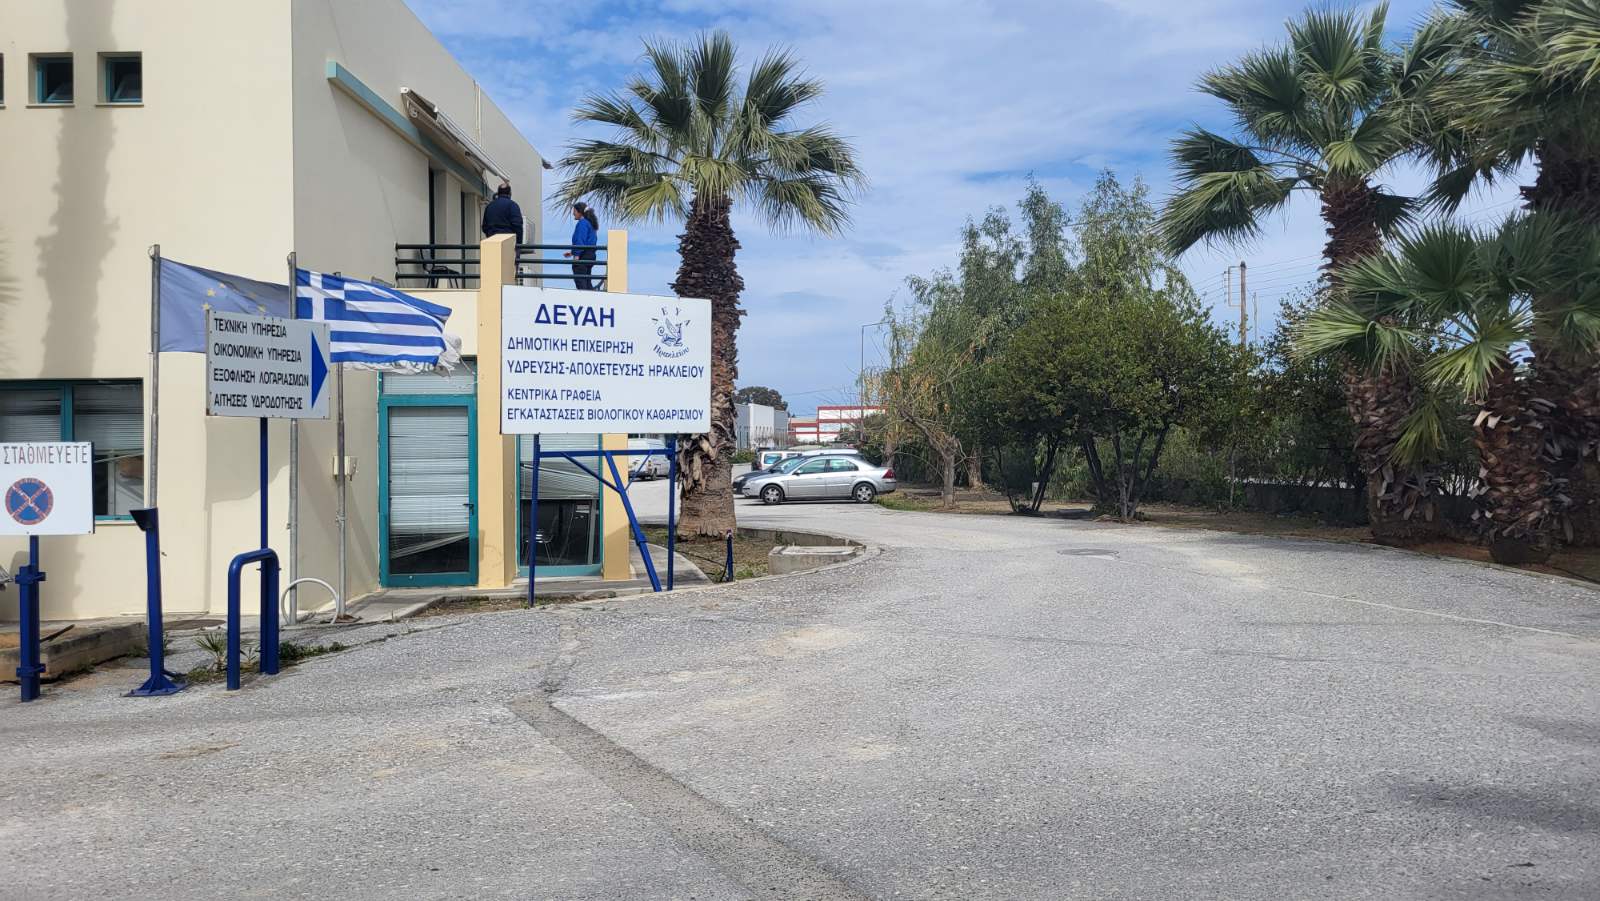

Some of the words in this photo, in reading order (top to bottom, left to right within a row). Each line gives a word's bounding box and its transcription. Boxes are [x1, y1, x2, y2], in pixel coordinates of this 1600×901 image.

[534, 303, 615, 328] ΔΕΥΑΗ
[214, 318, 247, 334] ΤΕΧΝΙΚΗ
[251, 322, 287, 338] ΥΠΗΡΕΣΙΑ
[214, 342, 264, 359] ΟΙΚΟΝΟΜΙΚΗ
[267, 347, 302, 363] ΥΠΗΡΕΣΙΑ
[507, 336, 568, 352] ΔΗΜΟΤΙΚΗ
[571, 339, 634, 354] ΕΠΙΧΕΙΡΗΣΗ
[213, 368, 256, 384] ΕΞΟΦΛΗΣΗ
[259, 371, 309, 387] ΛΟΓΑΡΙΑΣΜΩΝ
[507, 359, 645, 377] ΥΔΡΕΥΣΗΣ-ΑΠΟΧΕΤΕΥΣΗΣ
[648, 364, 705, 378] ΗΡΑΚΛΕΙΟΥ
[214, 393, 248, 408] ΑΙΤΗΣΕΙΣ
[251, 394, 303, 409] ΥΔΡΟΔΟΤΗΣΗΣ
[507, 388, 558, 401] ΚΕΝΤΡΙΚΑ
[560, 389, 602, 401] ΓΡΑΦΕΙΑ
[507, 407, 585, 421] ΕΓΚΑΤΑΣΤΑΣΕΙΣ
[587, 408, 645, 421] ΒΙΟΛΟΓΙΚΟΥ
[646, 409, 704, 421] ΚΑΘΑΡΙΣΜΟΥ
[3, 446, 88, 464] ΣΤΑΘΜΕΥΕΤΕ
